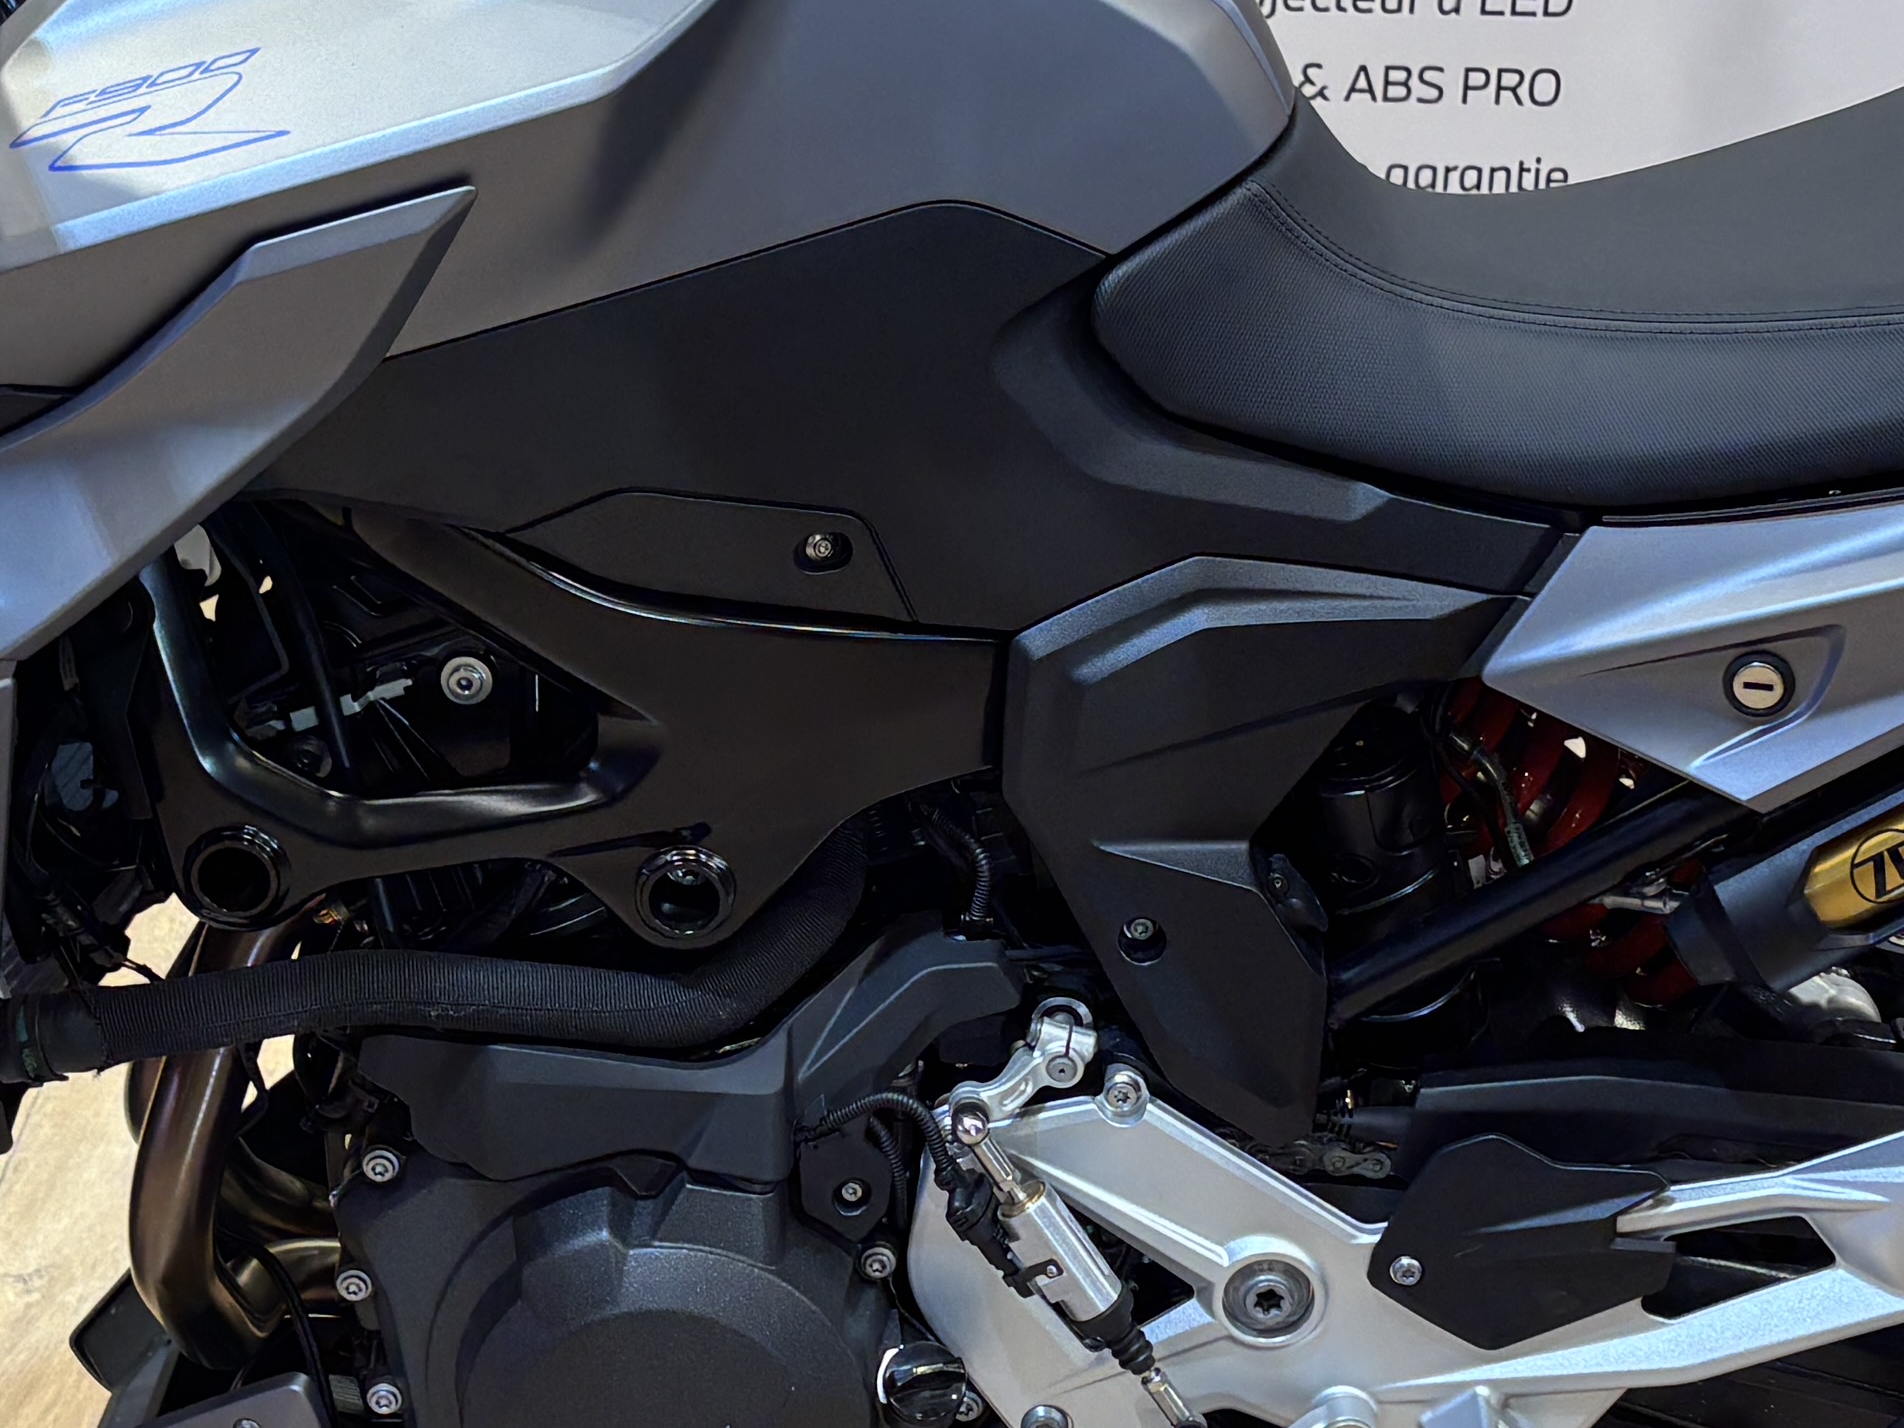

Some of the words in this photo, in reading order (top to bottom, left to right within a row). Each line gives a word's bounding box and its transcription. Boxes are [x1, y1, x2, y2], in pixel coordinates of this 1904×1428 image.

[39, 46, 261, 119] F900
[1298, 62, 1330, 103] &
[1344, 64, 1445, 104] ABS
[1461, 67, 1561, 107] PRO
